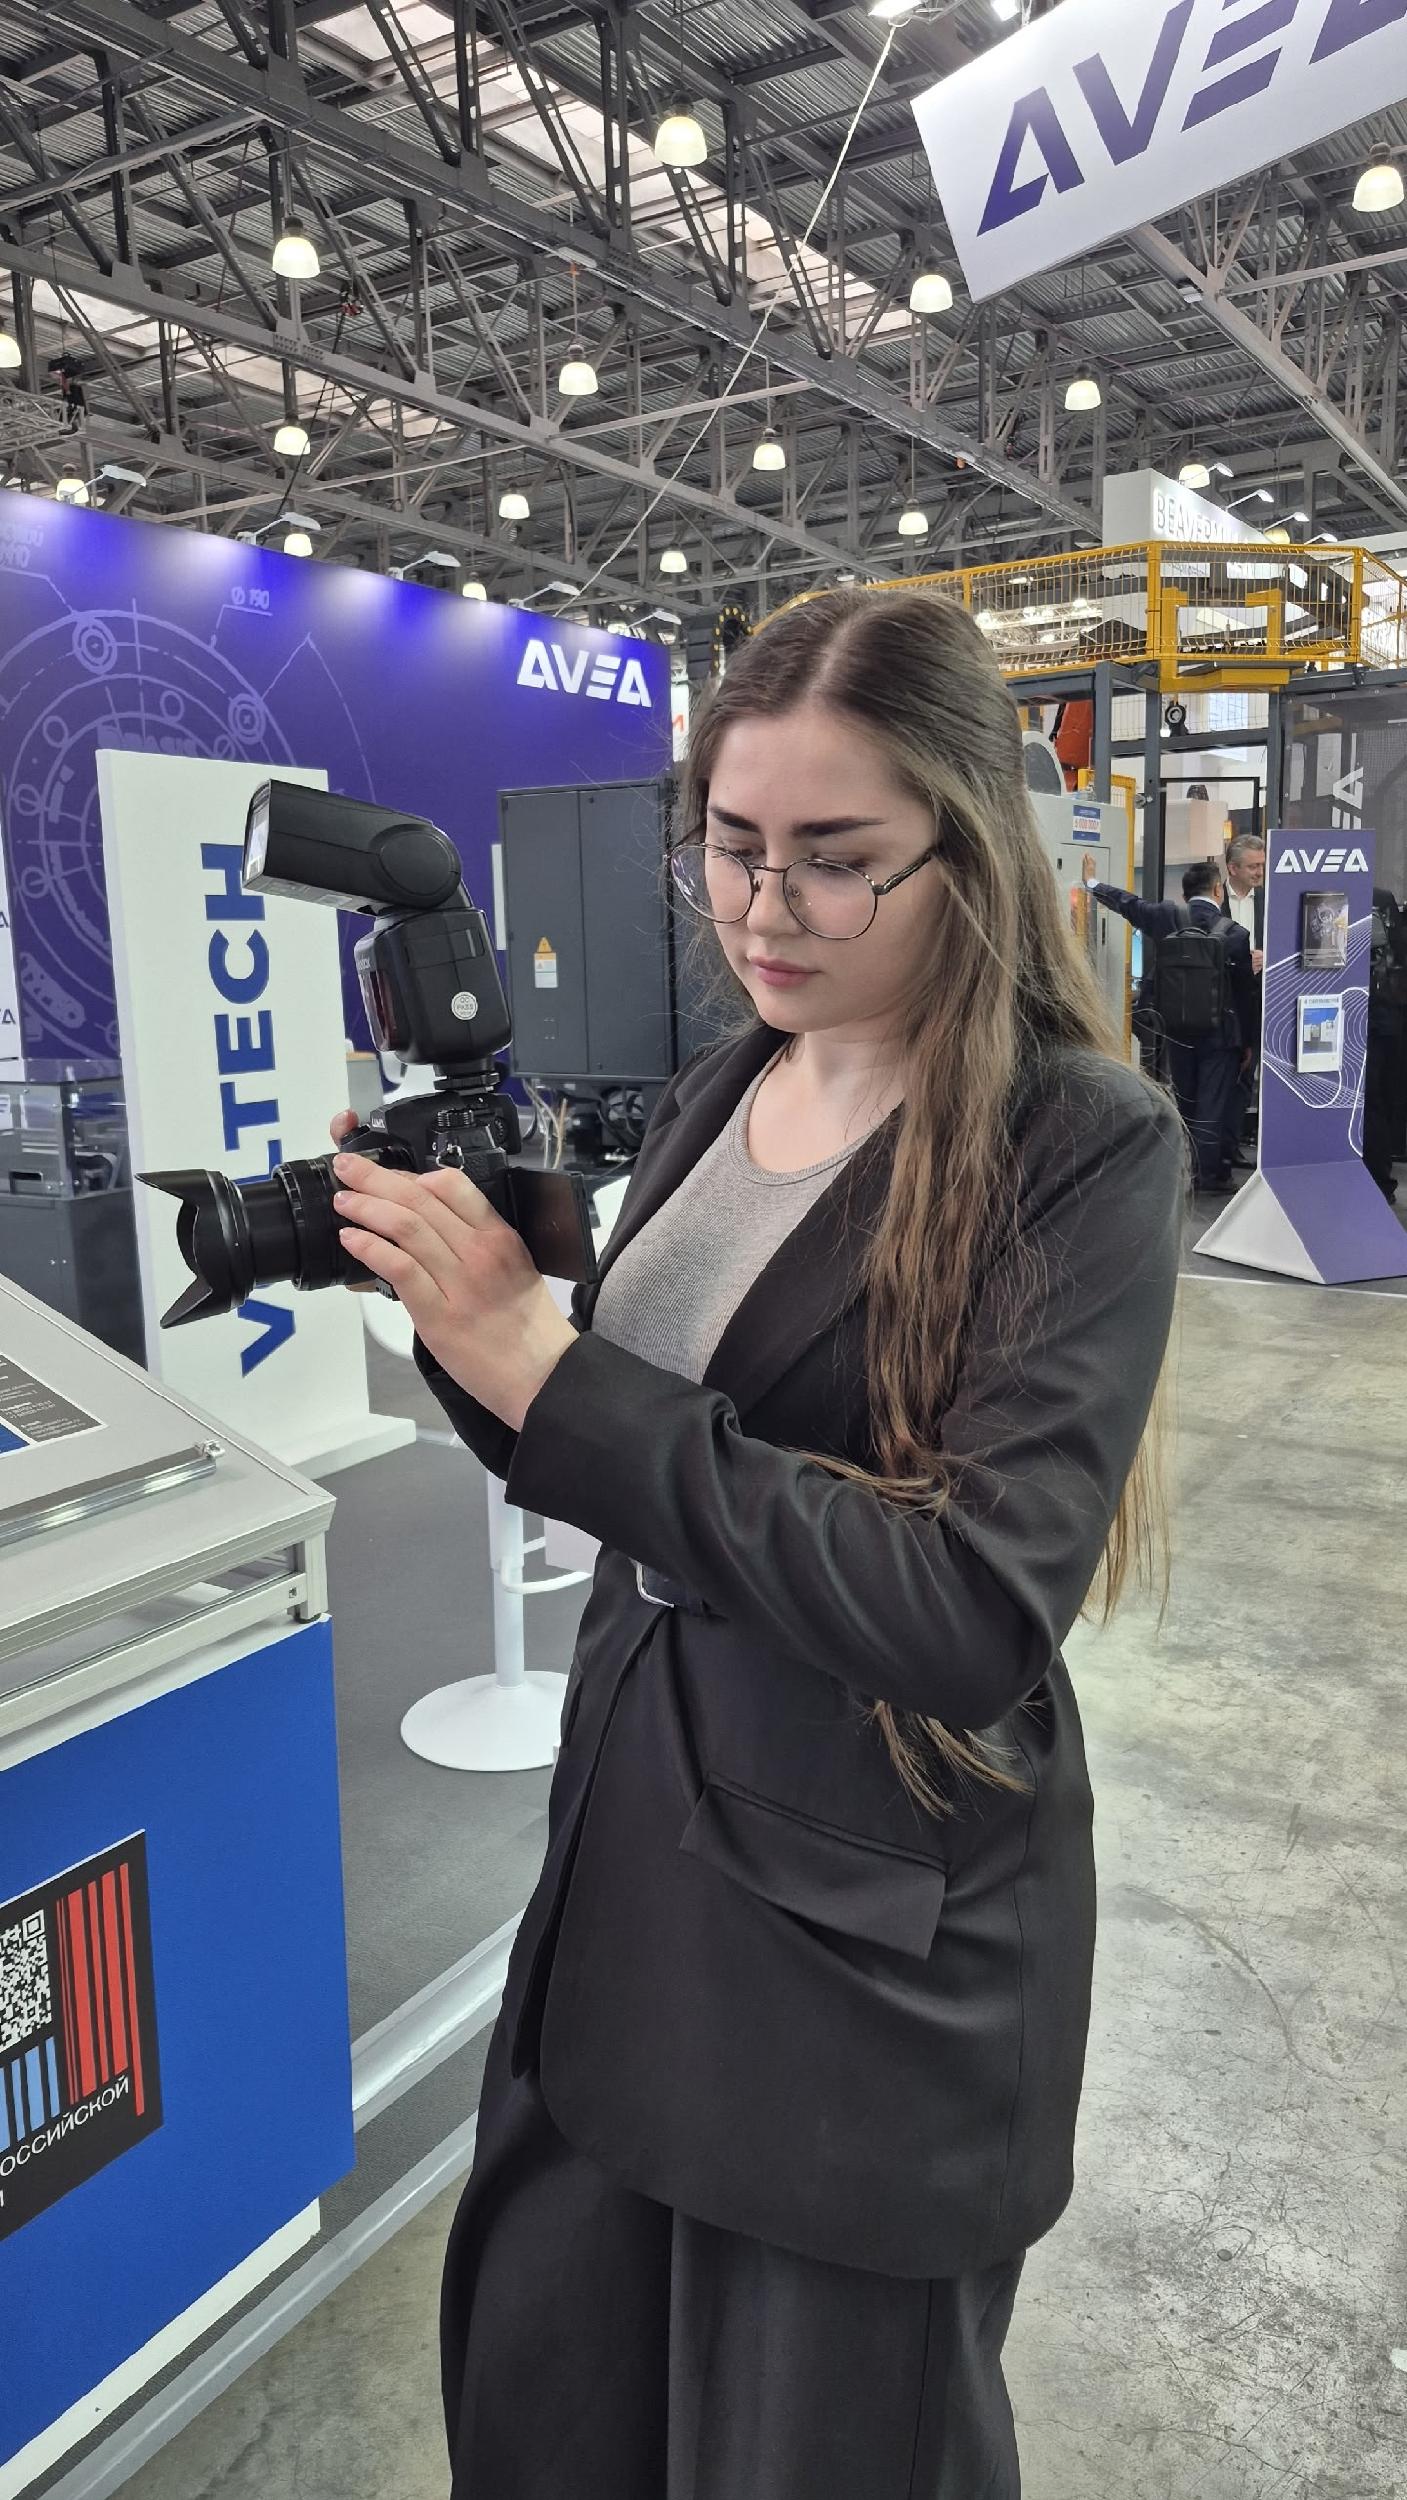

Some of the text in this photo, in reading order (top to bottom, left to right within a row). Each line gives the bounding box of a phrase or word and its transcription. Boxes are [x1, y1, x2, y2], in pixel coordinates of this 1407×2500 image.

[516, 639, 652, 708] AVEA
[1274, 848, 1369, 873] AVEA
[201, 842, 296, 1378] VLTECH
